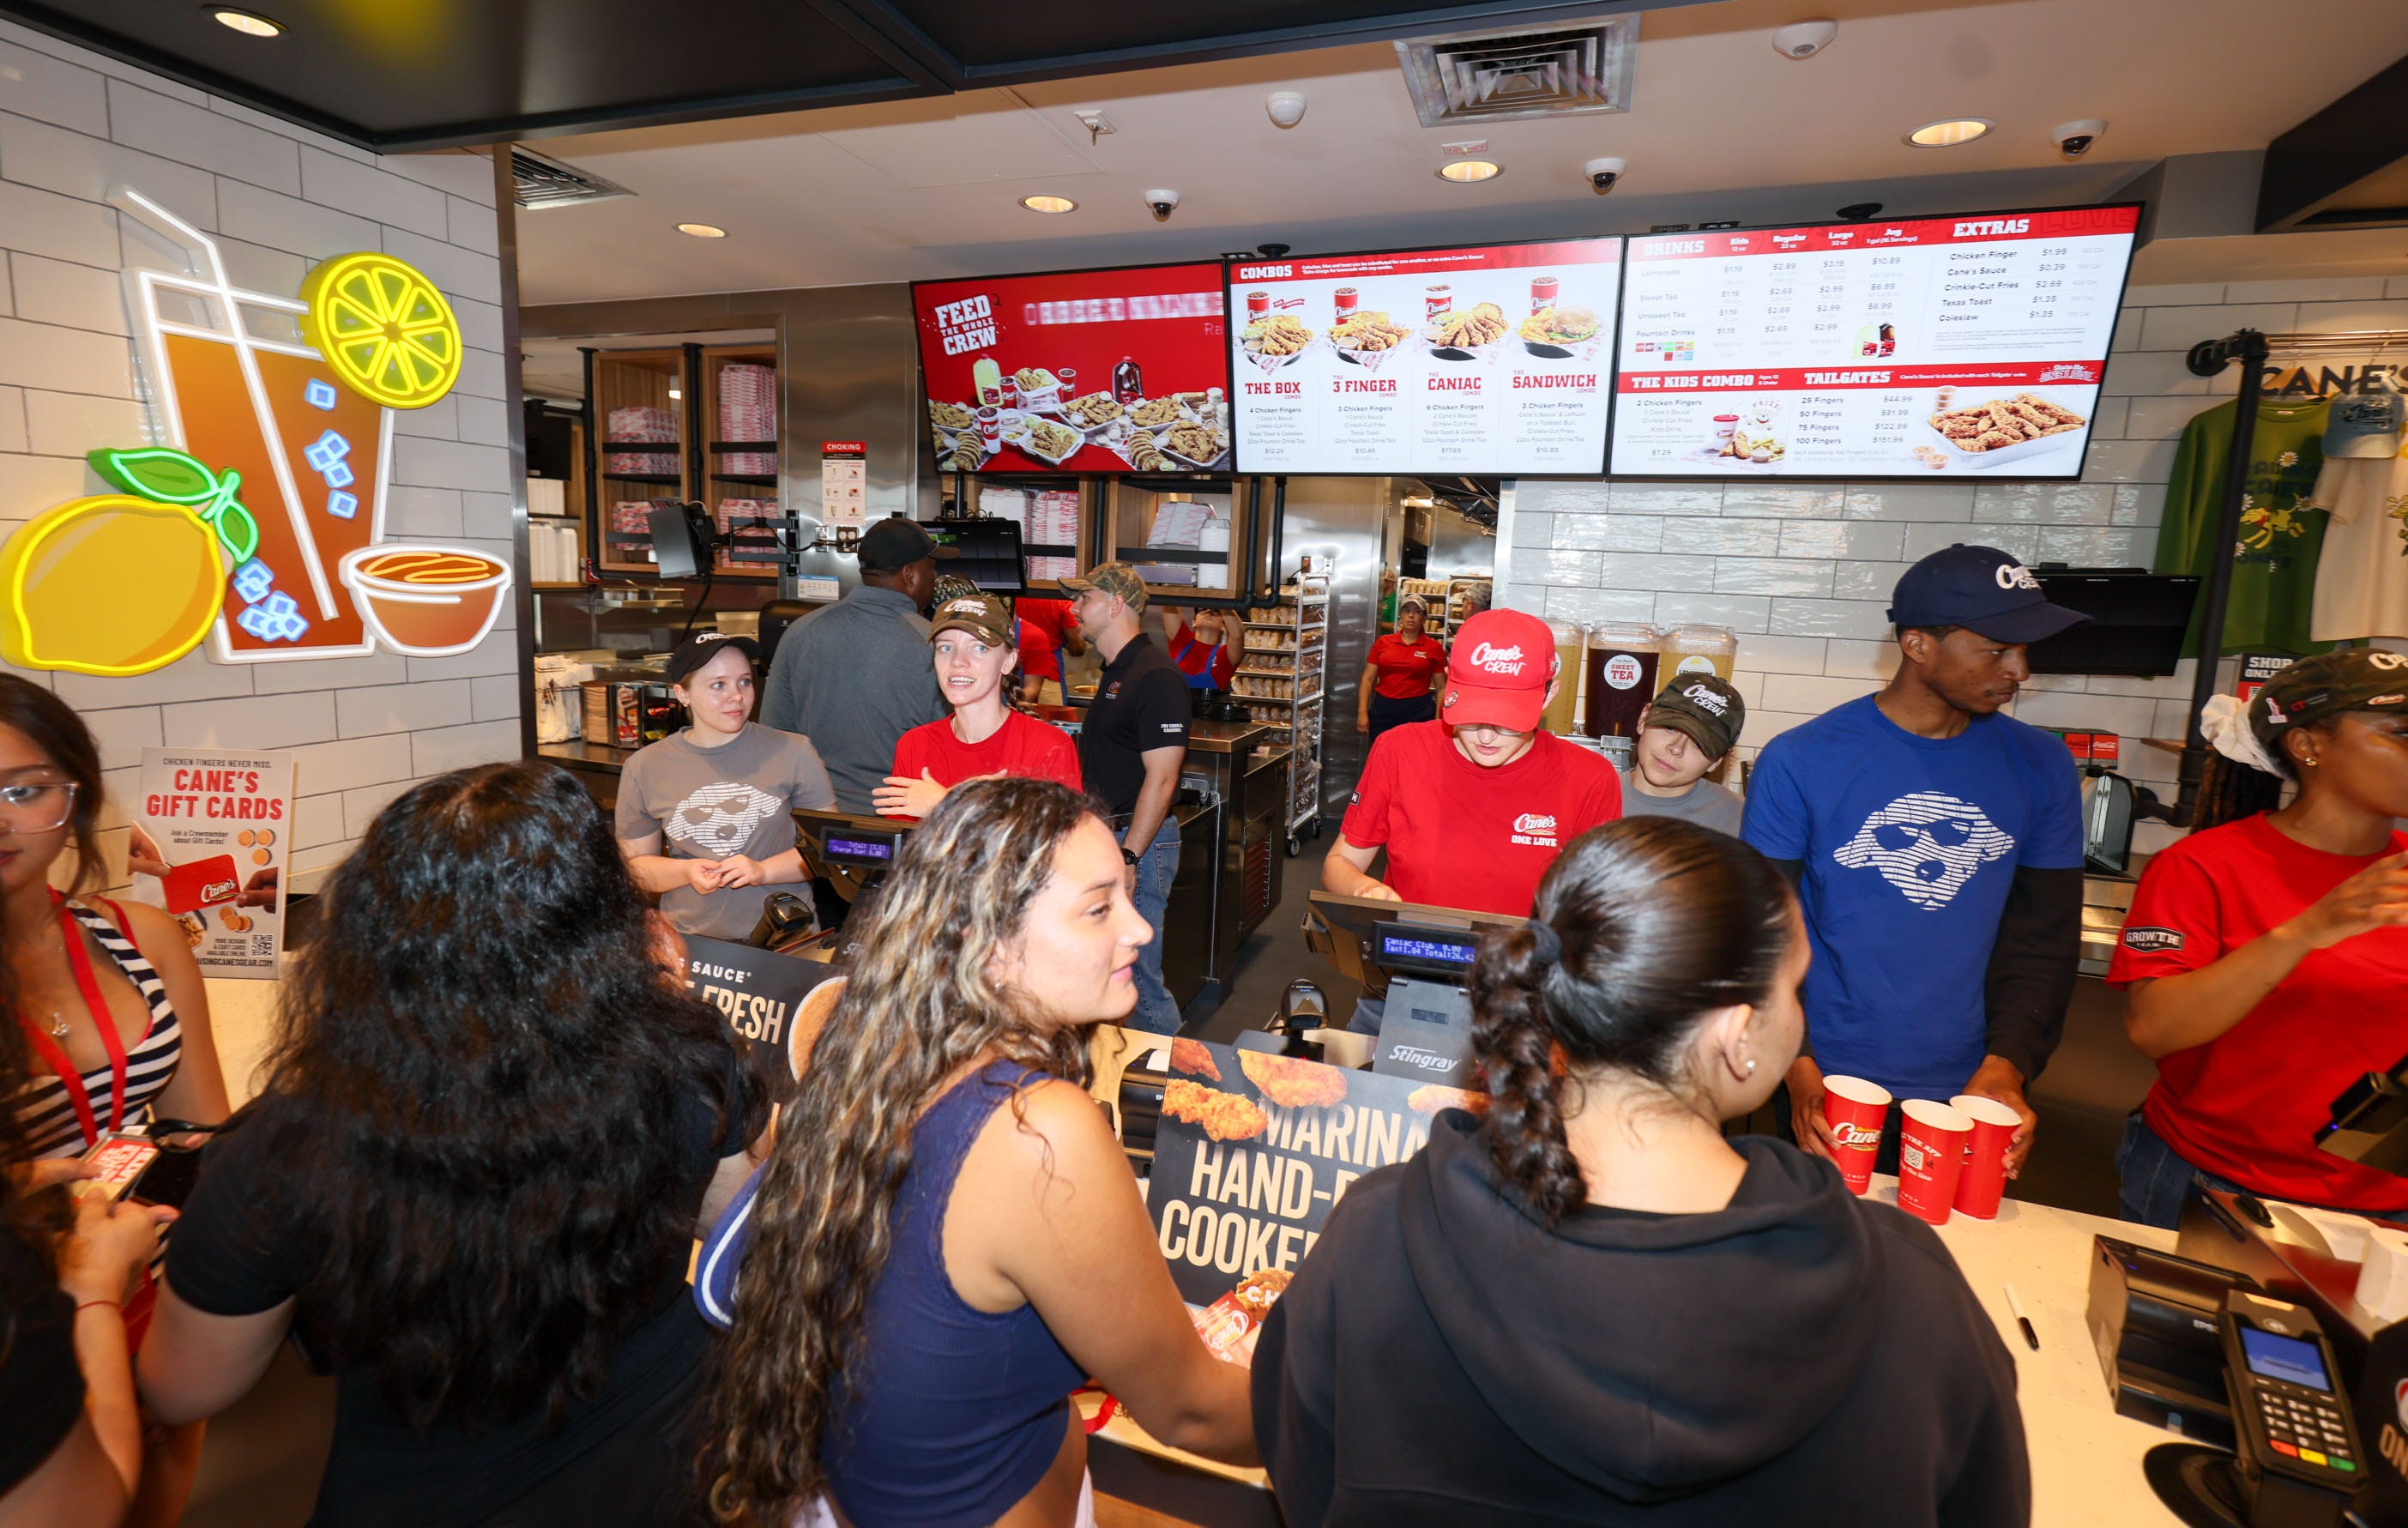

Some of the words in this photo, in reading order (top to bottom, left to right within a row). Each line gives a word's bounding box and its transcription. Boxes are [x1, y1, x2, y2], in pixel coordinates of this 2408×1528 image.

[1828, 231, 1854, 240] Large
[1884, 227, 1902, 238] Jug
[1953, 219, 2029, 237] EXTRAS
[1644, 241, 1705, 256] DRINKS
[1950, 251, 1986, 260] Chicken
[1988, 251, 2018, 259] Finger
[1240, 265, 1292, 279] COMBOS
[1944, 282, 1995, 291] Crinkle-Cut
[934, 294, 992, 328] FEED
[940, 326, 959, 336] THE
[962, 317, 994, 331] WHOLE
[1636, 329, 1668, 337] Fountain
[943, 326, 996, 355] CREW
[1428, 377, 1481, 390] CANIAC
[1512, 374, 1596, 389] SANDWICH
[1632, 377, 1660, 388] THE
[1663, 376, 1699, 388] KIDS
[1702, 375, 1753, 387] COMBO
[1804, 371, 1890, 384] TAILGATES
[1245, 383, 1271, 394] THE
[1275, 382, 1301, 393] BOX
[1333, 381, 1341, 392] 3
[1345, 380, 1397, 392] FINGER
[1814, 396, 1844, 405] Fingers
[1813, 410, 1841, 419] Fingers
[1810, 424, 1839, 432] Fingers
[1813, 438, 1841, 446] Fingers
[1470, 642, 1524, 666] Cane's
[1484, 662, 1523, 676] CREW
[2248, 656, 2294, 669] SHOP
[1611, 670, 1634, 680] TEA
[1683, 685, 1729, 707] Cane's
[1693, 697, 1726, 717] CREW
[174, 769, 258, 794] CANE'S
[147, 794, 198, 817] GIFT
[206, 796, 282, 820] CARDS
[1514, 813, 1557, 833] Cane's
[1512, 835, 1531, 845] ONE
[1533, 837, 1557, 847] LOVE
[200, 879, 236, 903] Cane's
[1385, 938, 1412, 947] Caniac
[1416, 941, 1434, 950] Club
[2126, 931, 2180, 945] GROWTH
[691, 961, 745, 983] SAUCE
[1389, 1045, 1457, 1072] Stingray
